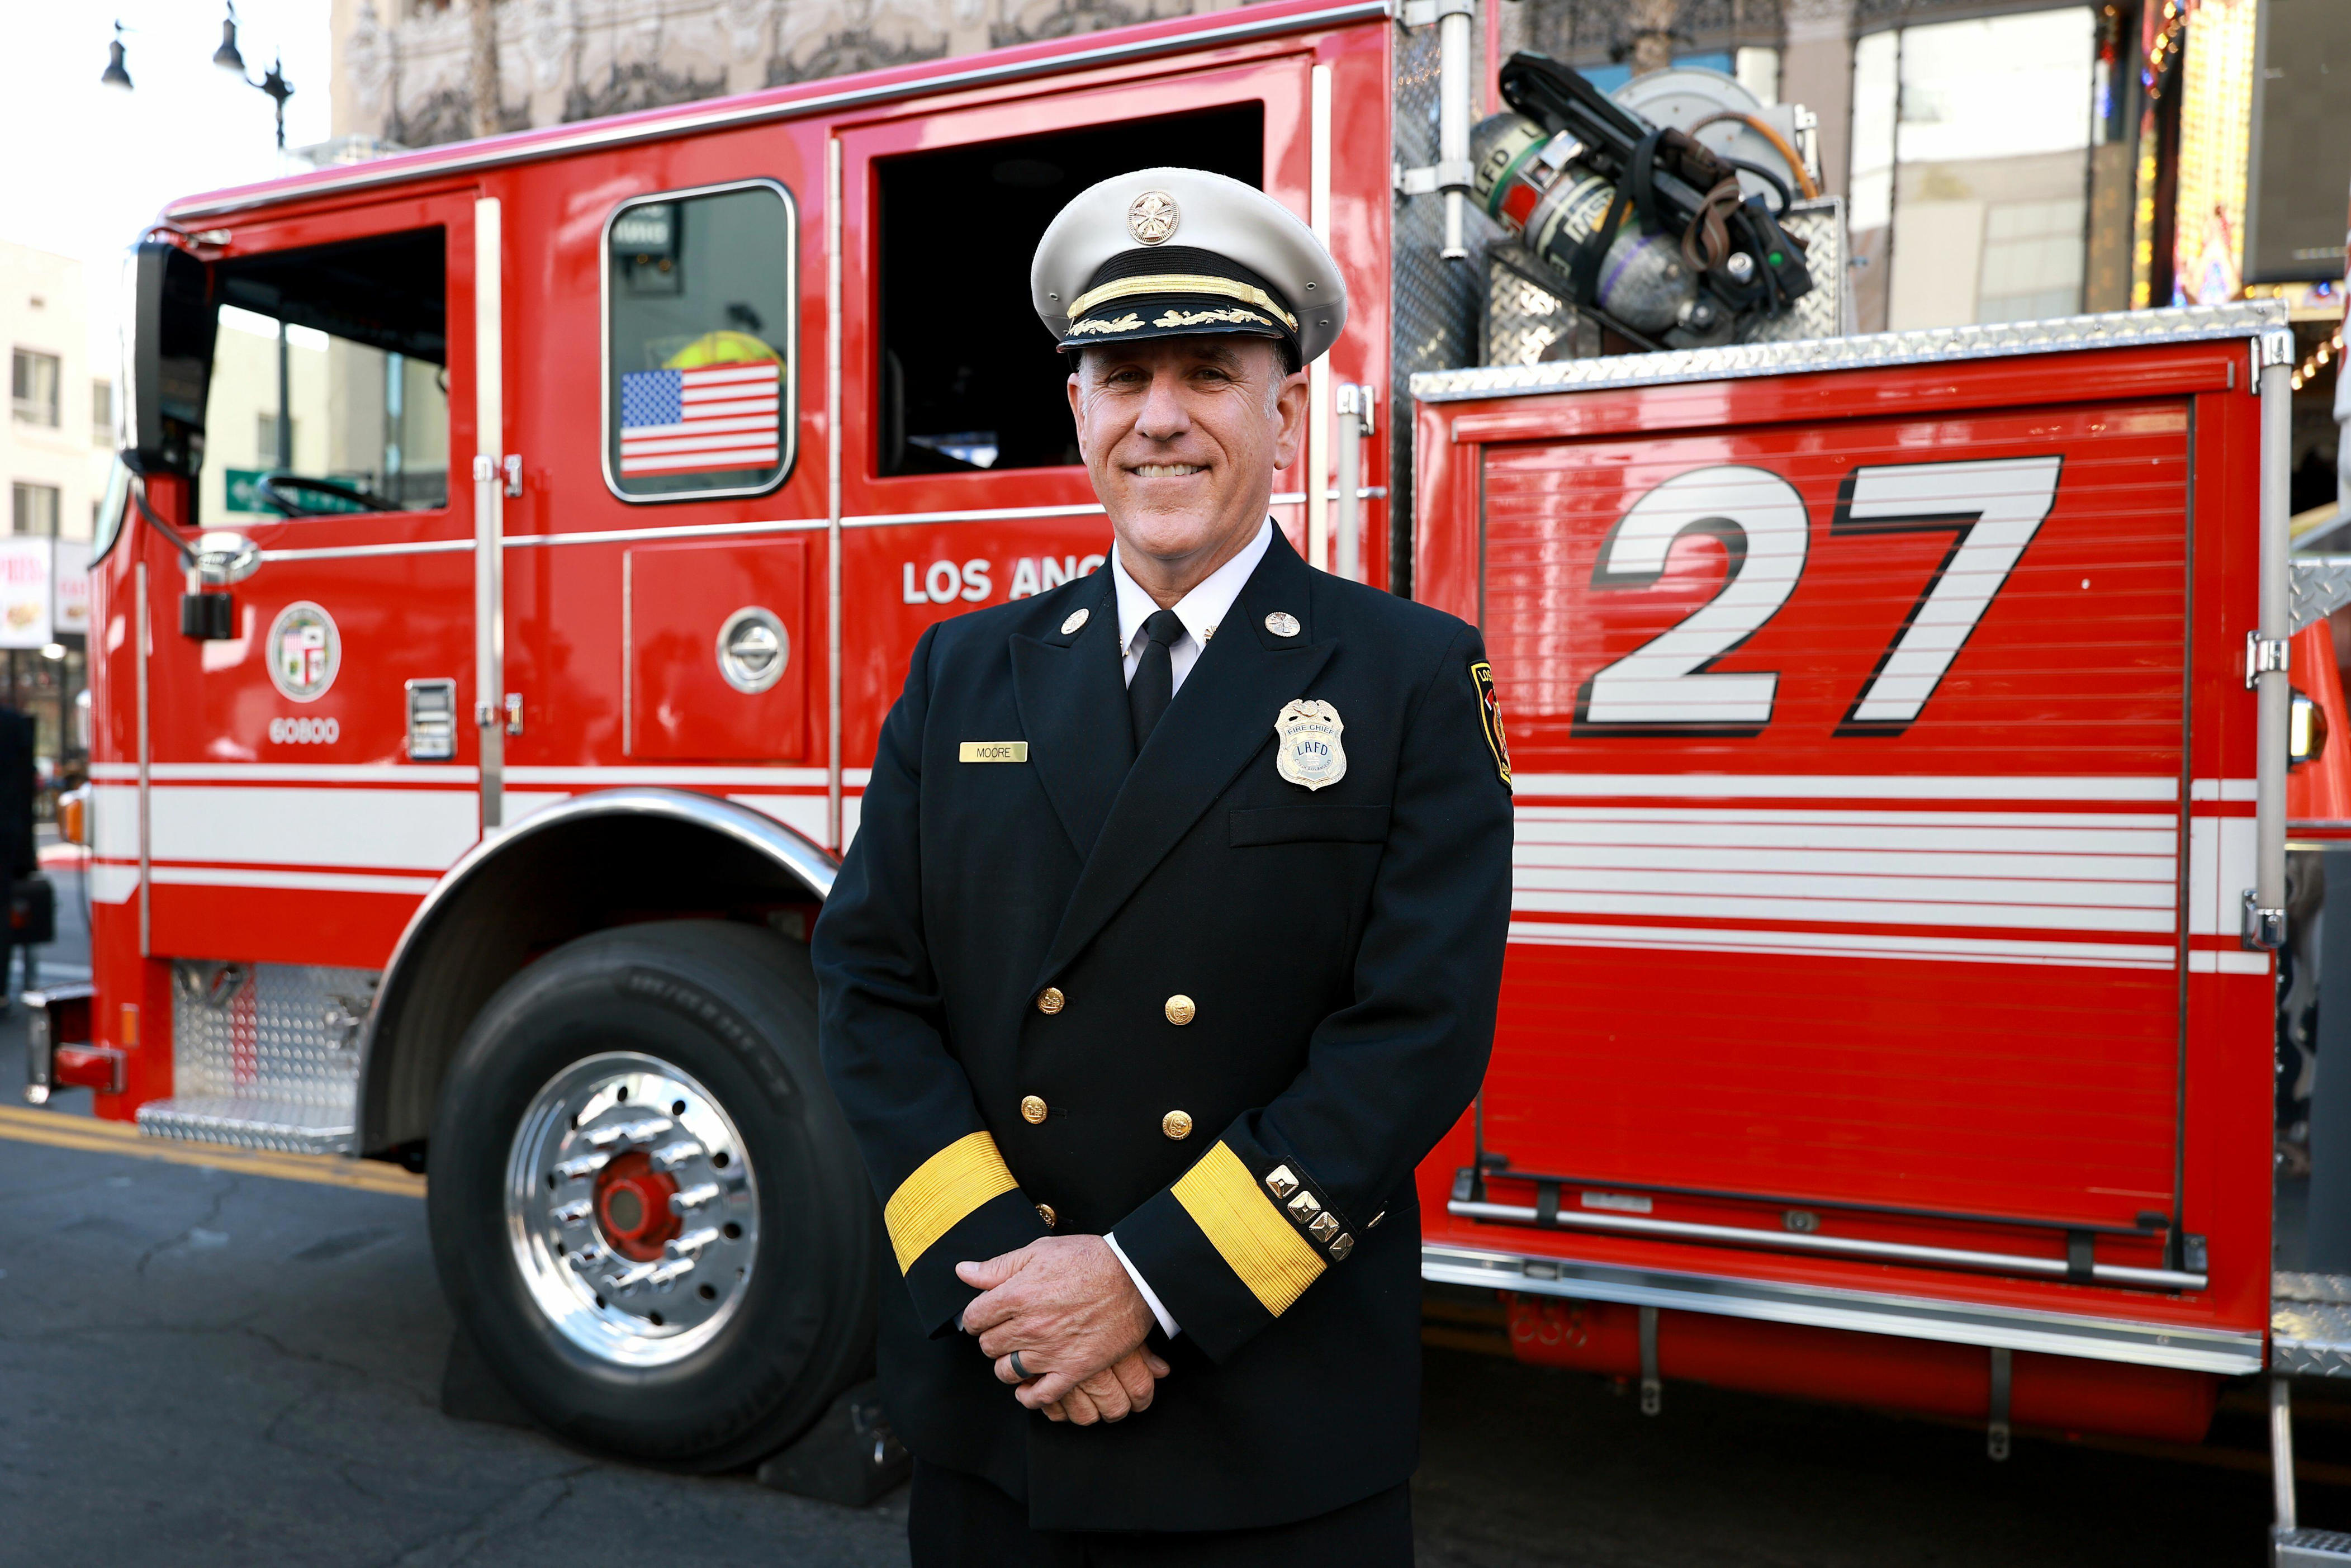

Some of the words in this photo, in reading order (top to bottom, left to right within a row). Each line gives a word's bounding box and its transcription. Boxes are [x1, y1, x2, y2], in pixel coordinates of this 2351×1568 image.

[903, 558, 992, 604] LOS
[1570, 454, 2065, 737] 27
[268, 717, 340, 745] 60800
[1287, 724, 1306, 735] FIRE
[1309, 724, 1334, 735] CHIEF
[977, 747, 1011, 758] MOORE
[1297, 741, 1328, 756] LAFD
